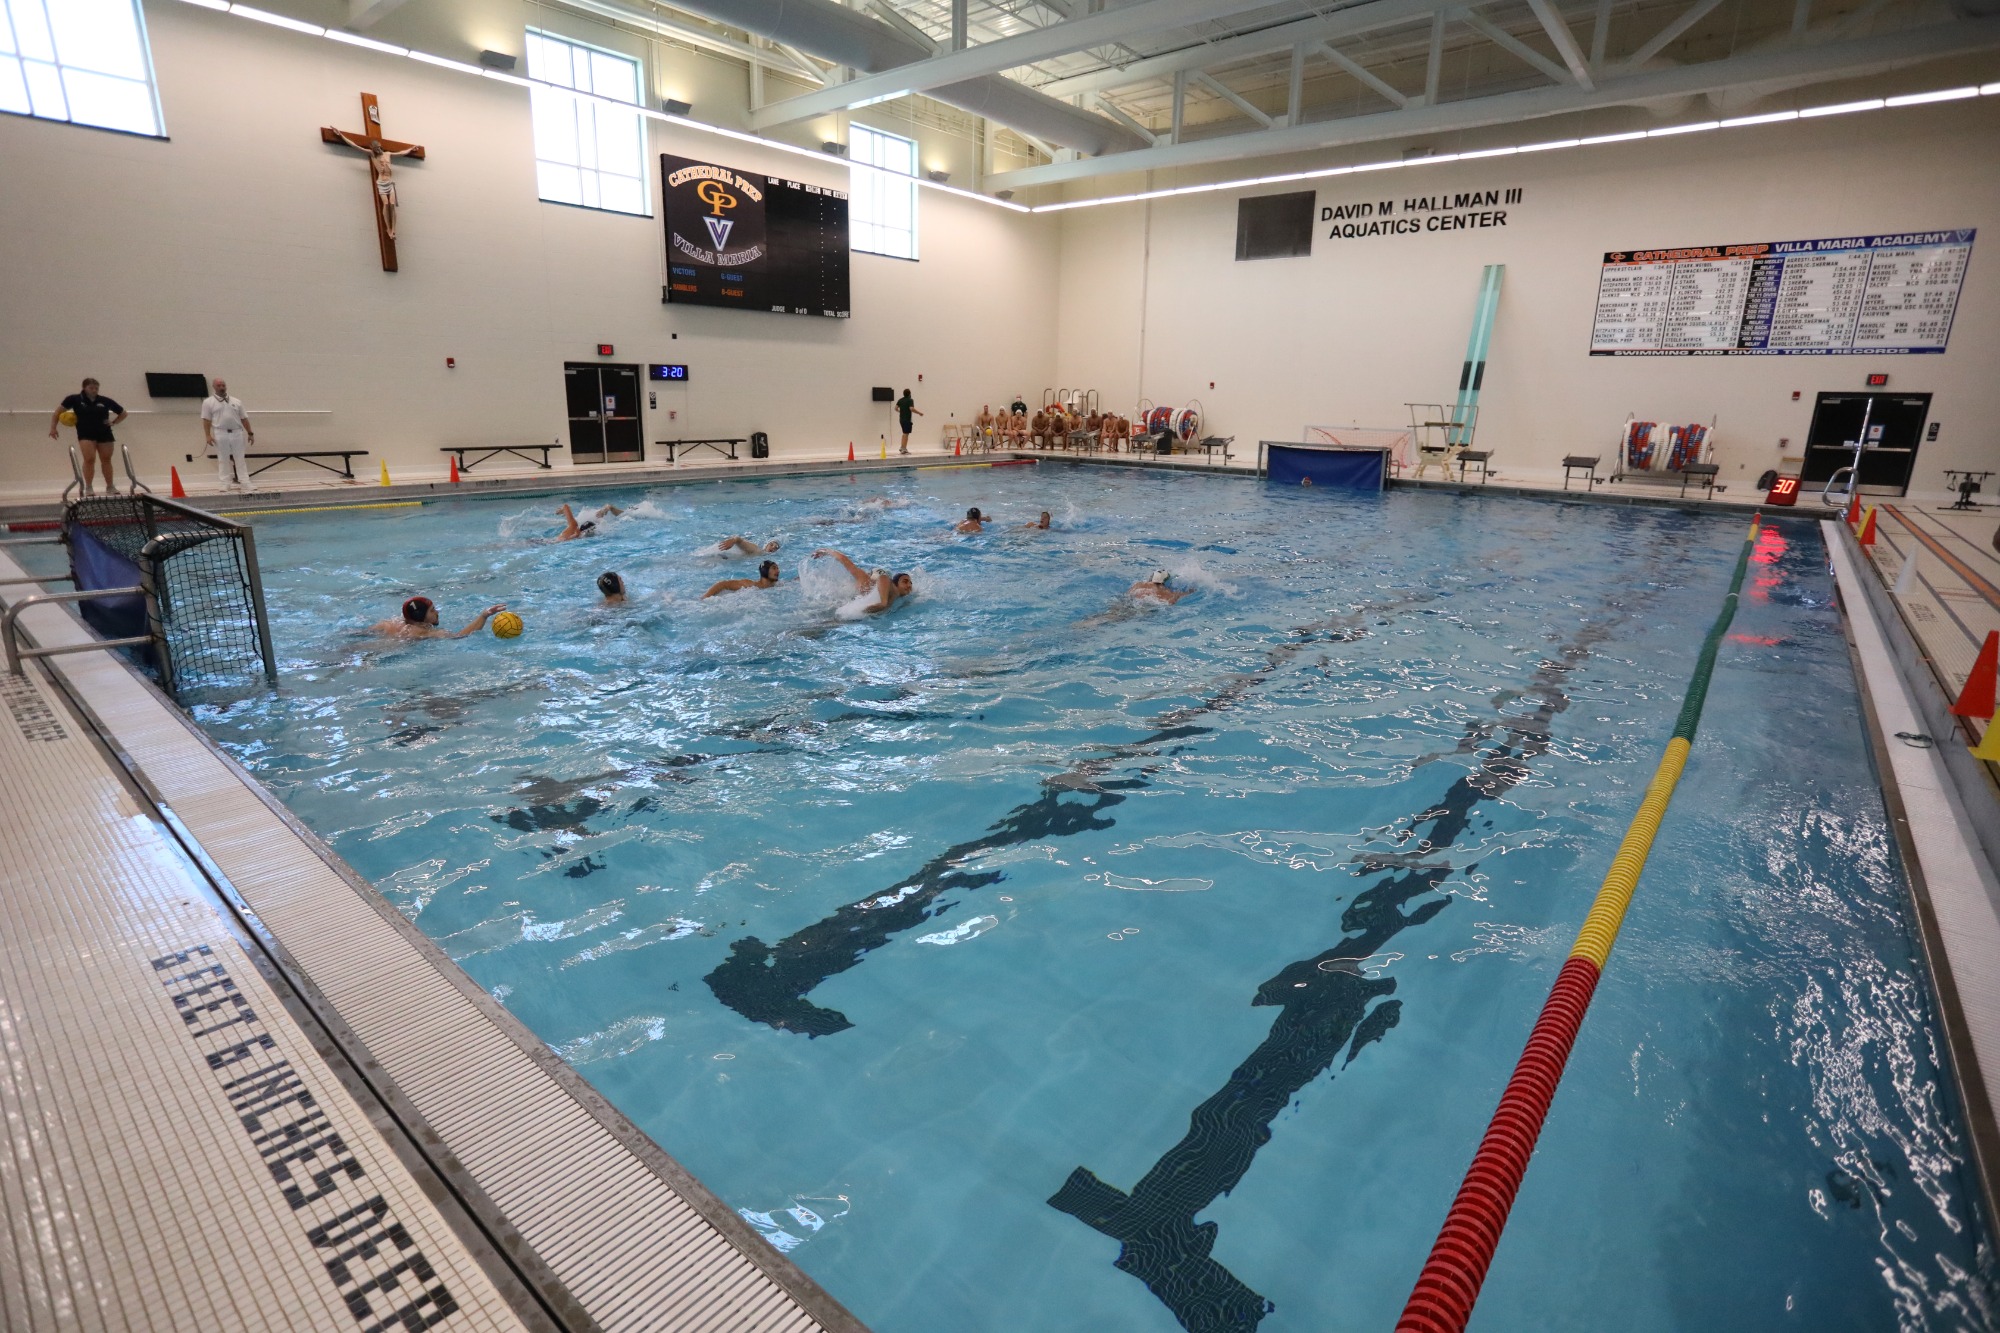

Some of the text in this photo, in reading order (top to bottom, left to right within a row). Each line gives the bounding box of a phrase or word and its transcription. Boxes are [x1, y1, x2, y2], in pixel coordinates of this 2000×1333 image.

[669, 166, 762, 202] CATHEDRAL PREP
[787, 181, 800, 190] PLACE
[1322, 203, 1372, 221] DAVID
[1404, 190, 1499, 212] HALLMAN
[1505, 188, 1522, 204] III
[1329, 210, 1508, 239] AQUATICS CENTER
[674, 232, 762, 265] VILLA MARIA
[1633, 247, 1721, 261] CATHEDRAL
[1726, 244, 1769, 256] PREP
[1775, 242, 1813, 252] VILLA
[1817, 239, 1865, 250] MARIA
[1871, 232, 1951, 247] ACADEMY
[673, 267, 696, 277] VICTORS
[662, 367, 682, 378] 3:20
[1871, 376, 1885, 384] EXIT
[1772, 480, 1796, 494] 30
[163, 963, 258, 1038] FEET
[206, 1033, 276, 1070] 6
[223, 1060, 366, 1211] INCHES
[307, 1195, 460, 1333] DEEP
